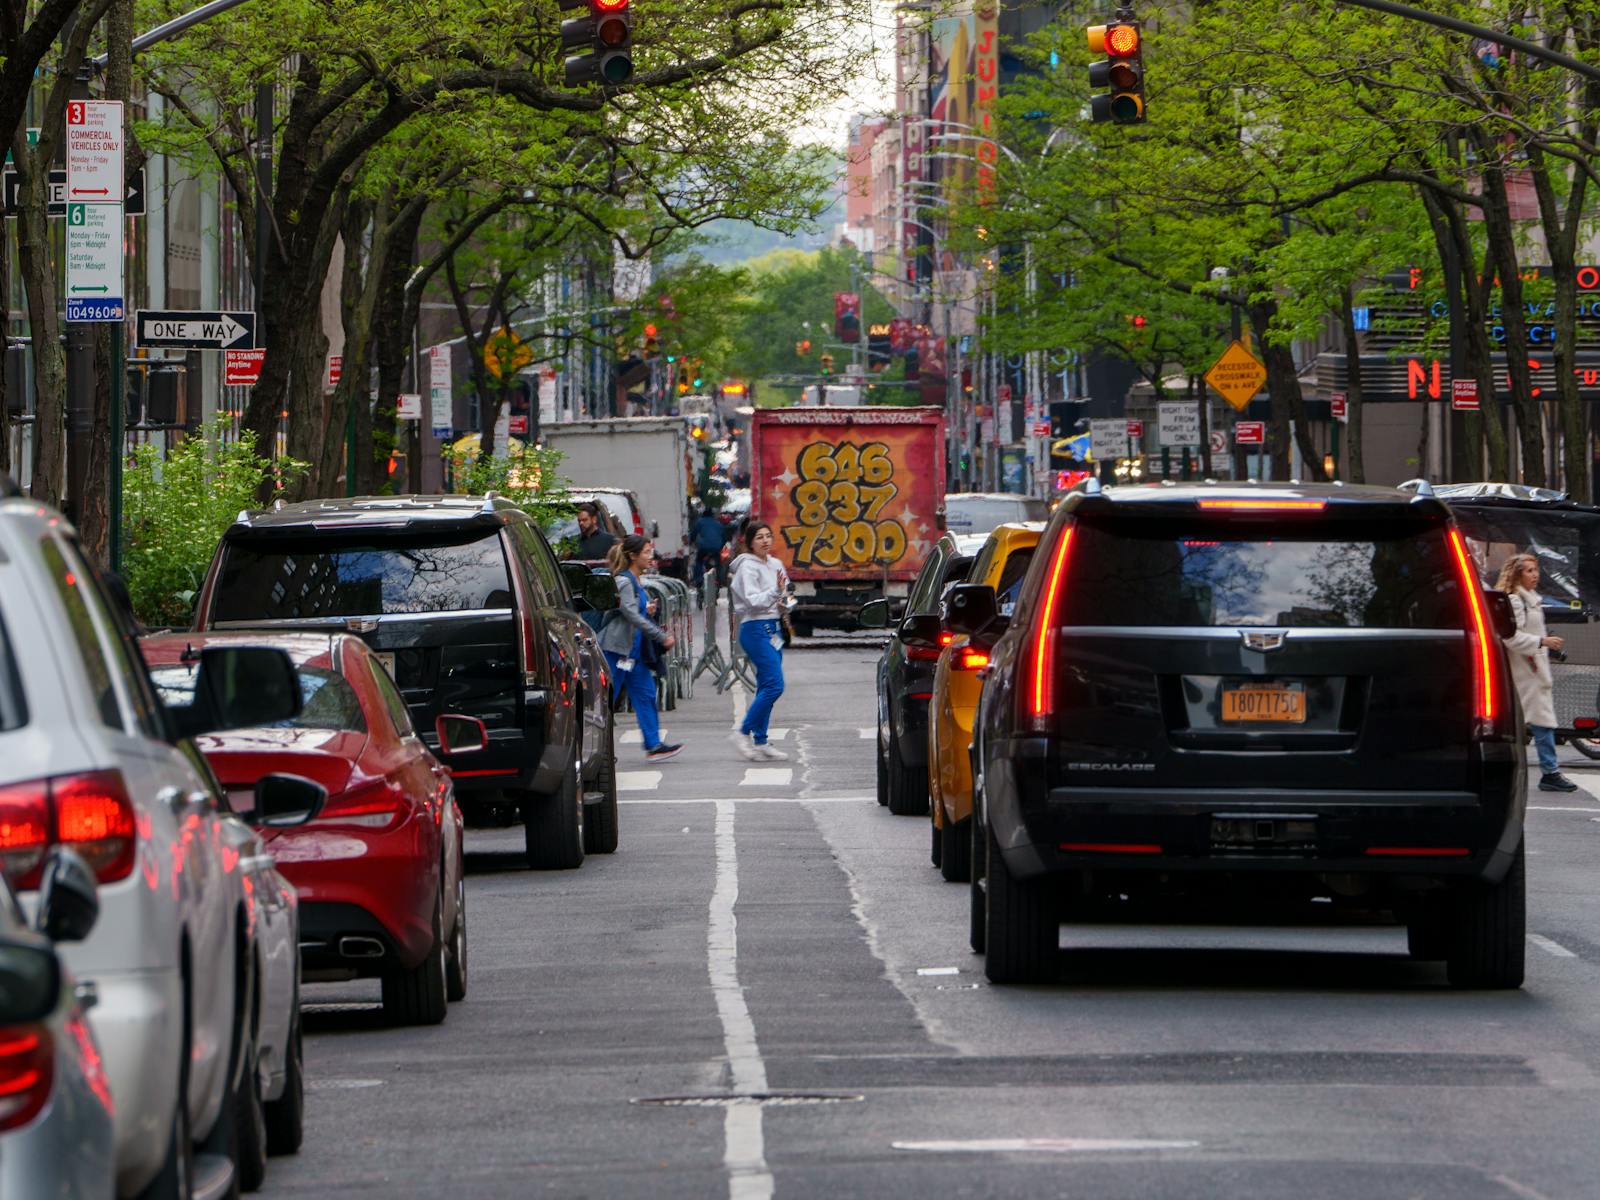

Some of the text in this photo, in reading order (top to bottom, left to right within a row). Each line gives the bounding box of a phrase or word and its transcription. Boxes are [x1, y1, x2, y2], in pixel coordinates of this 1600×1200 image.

[72, 104, 82, 124] 3
[71, 130, 112, 140] COMMERCIAL
[71, 142, 119, 151] VEHICLES ONLY
[71, 155, 89, 164] Monday
[94, 155, 109, 165] Friday
[72, 205, 82, 225] 6
[70, 231, 90, 240] Monday
[95, 231, 111, 240] Friday
[85, 240, 106, 249] Midnight
[70, 253, 94, 261] Saturday
[85, 262, 106, 271] Midnight
[154, 322, 237, 339] ONE WAY
[227, 352, 265, 361] NO STANDING
[227, 360, 251, 370] Anytime
[1214, 372, 1260, 381] CROSSWALK
[1174, 415, 1195, 423] FROM
[1162, 424, 1183, 432] RIGHT
[798, 441, 893, 485] 646
[793, 480, 898, 525] 837
[782, 519, 907, 567] 7300
